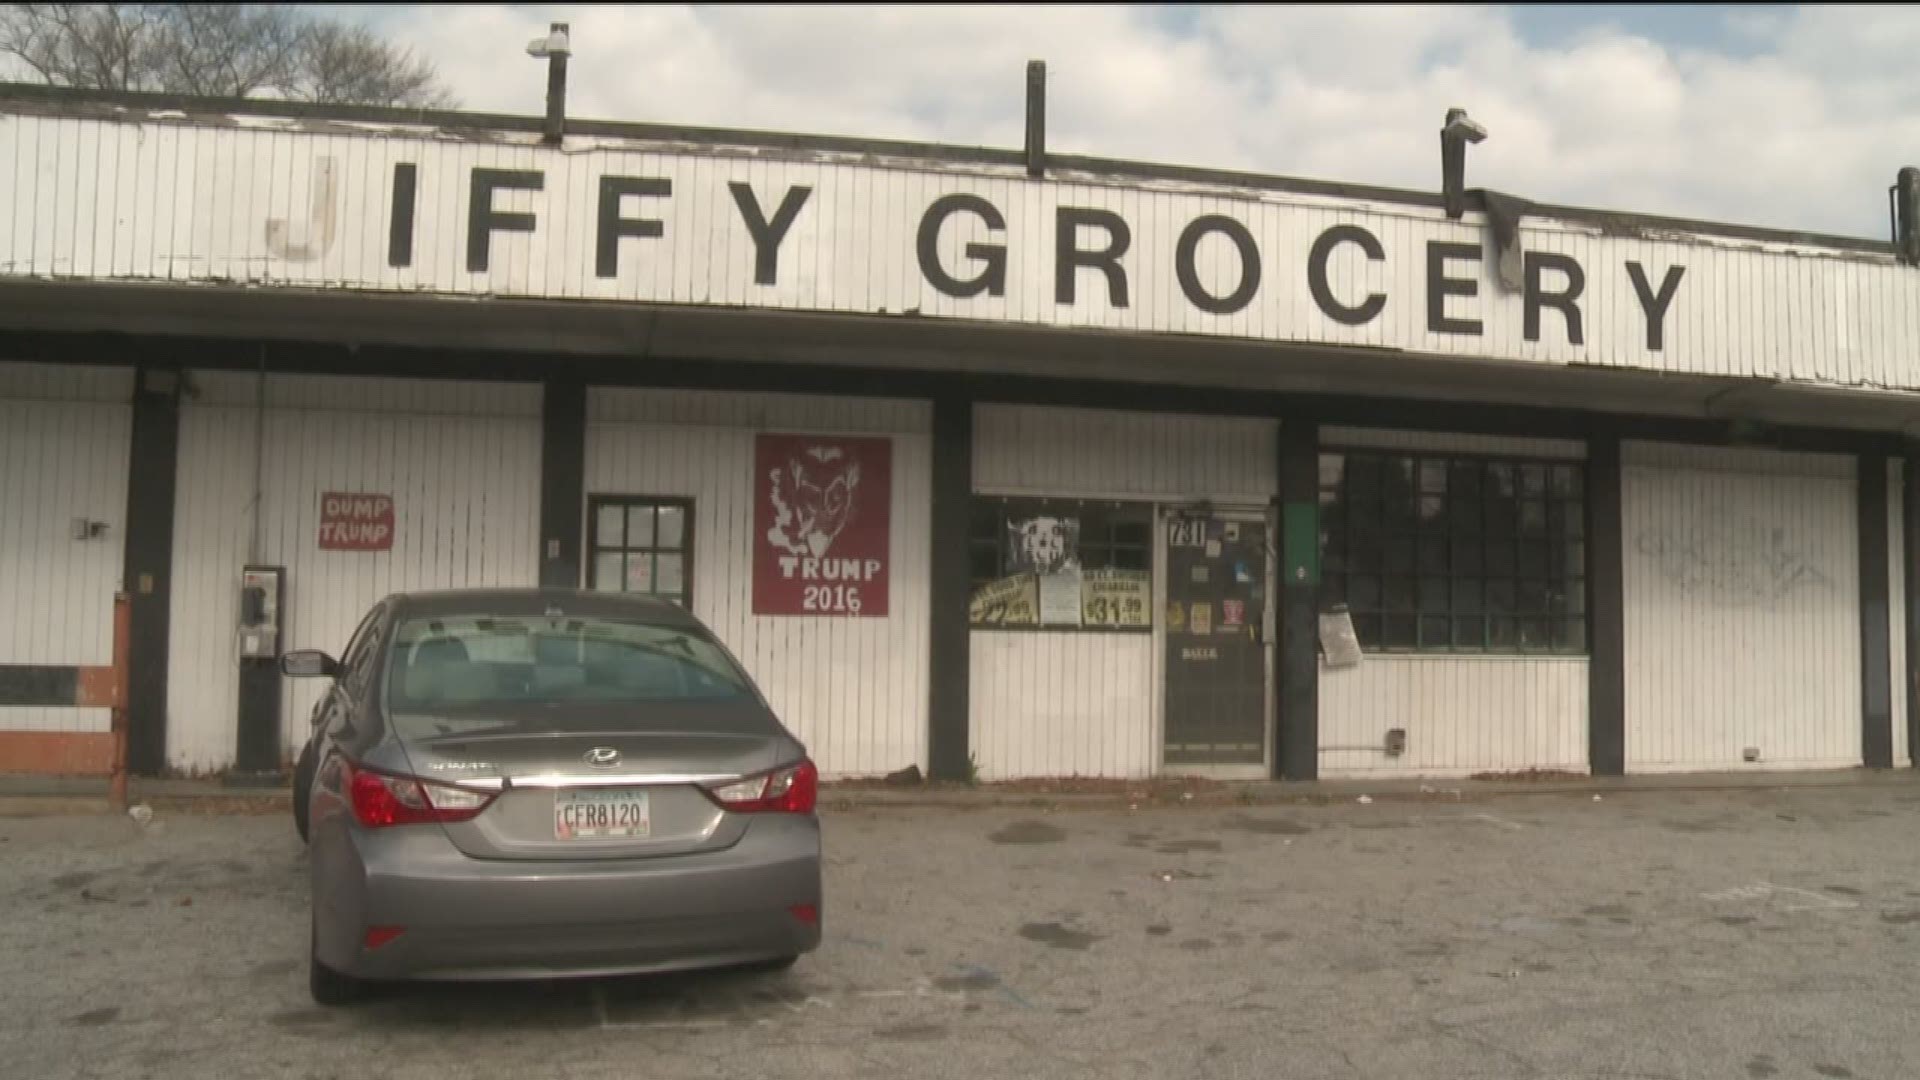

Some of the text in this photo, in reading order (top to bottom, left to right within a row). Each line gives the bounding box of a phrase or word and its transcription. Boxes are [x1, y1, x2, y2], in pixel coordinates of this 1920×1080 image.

[265, 154, 1686, 351] JIFFY GROCERY
[326, 499, 389, 518] DUMP
[321, 522, 389, 543] TRUMP
[779, 556, 880, 581] TRUMP
[803, 584, 861, 613] 2016
[564, 803, 640, 829] CFR8120
